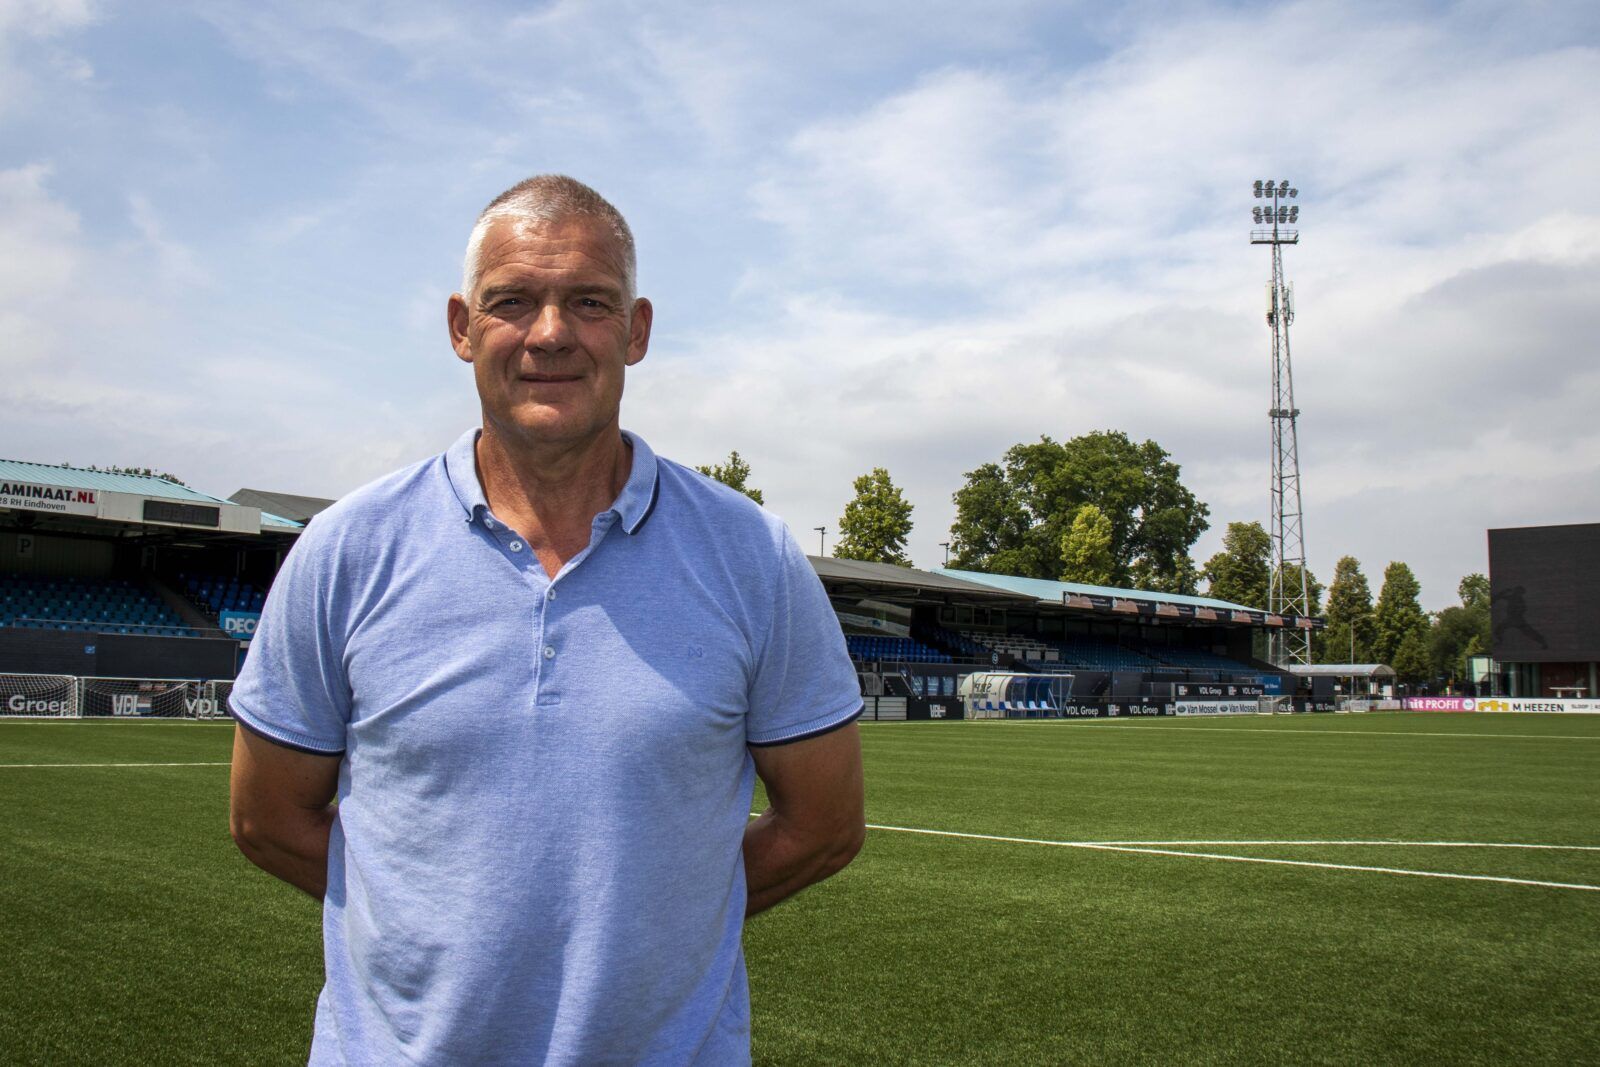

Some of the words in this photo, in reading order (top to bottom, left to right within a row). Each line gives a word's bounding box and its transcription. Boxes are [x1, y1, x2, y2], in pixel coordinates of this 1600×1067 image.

[10, 498, 22, 507] RH
[24, 500, 66, 511] Eindhoven
[20, 538, 31, 553] P
[112, 694, 141, 716] VDL
[184, 699, 224, 715] VDL
[1129, 705, 1142, 714] VDL
[1142, 705, 1159, 717] Groep
[1187, 703, 1198, 714] Van
[1199, 703, 1218, 714] Mossel
[1425, 700, 1459, 709] PROFIT
[1512, 703, 1522, 711] M
[1524, 703, 1564, 712] HEEZEN
[1066, 705, 1080, 715] VDL
[1080, 706, 1099, 718] Groep
